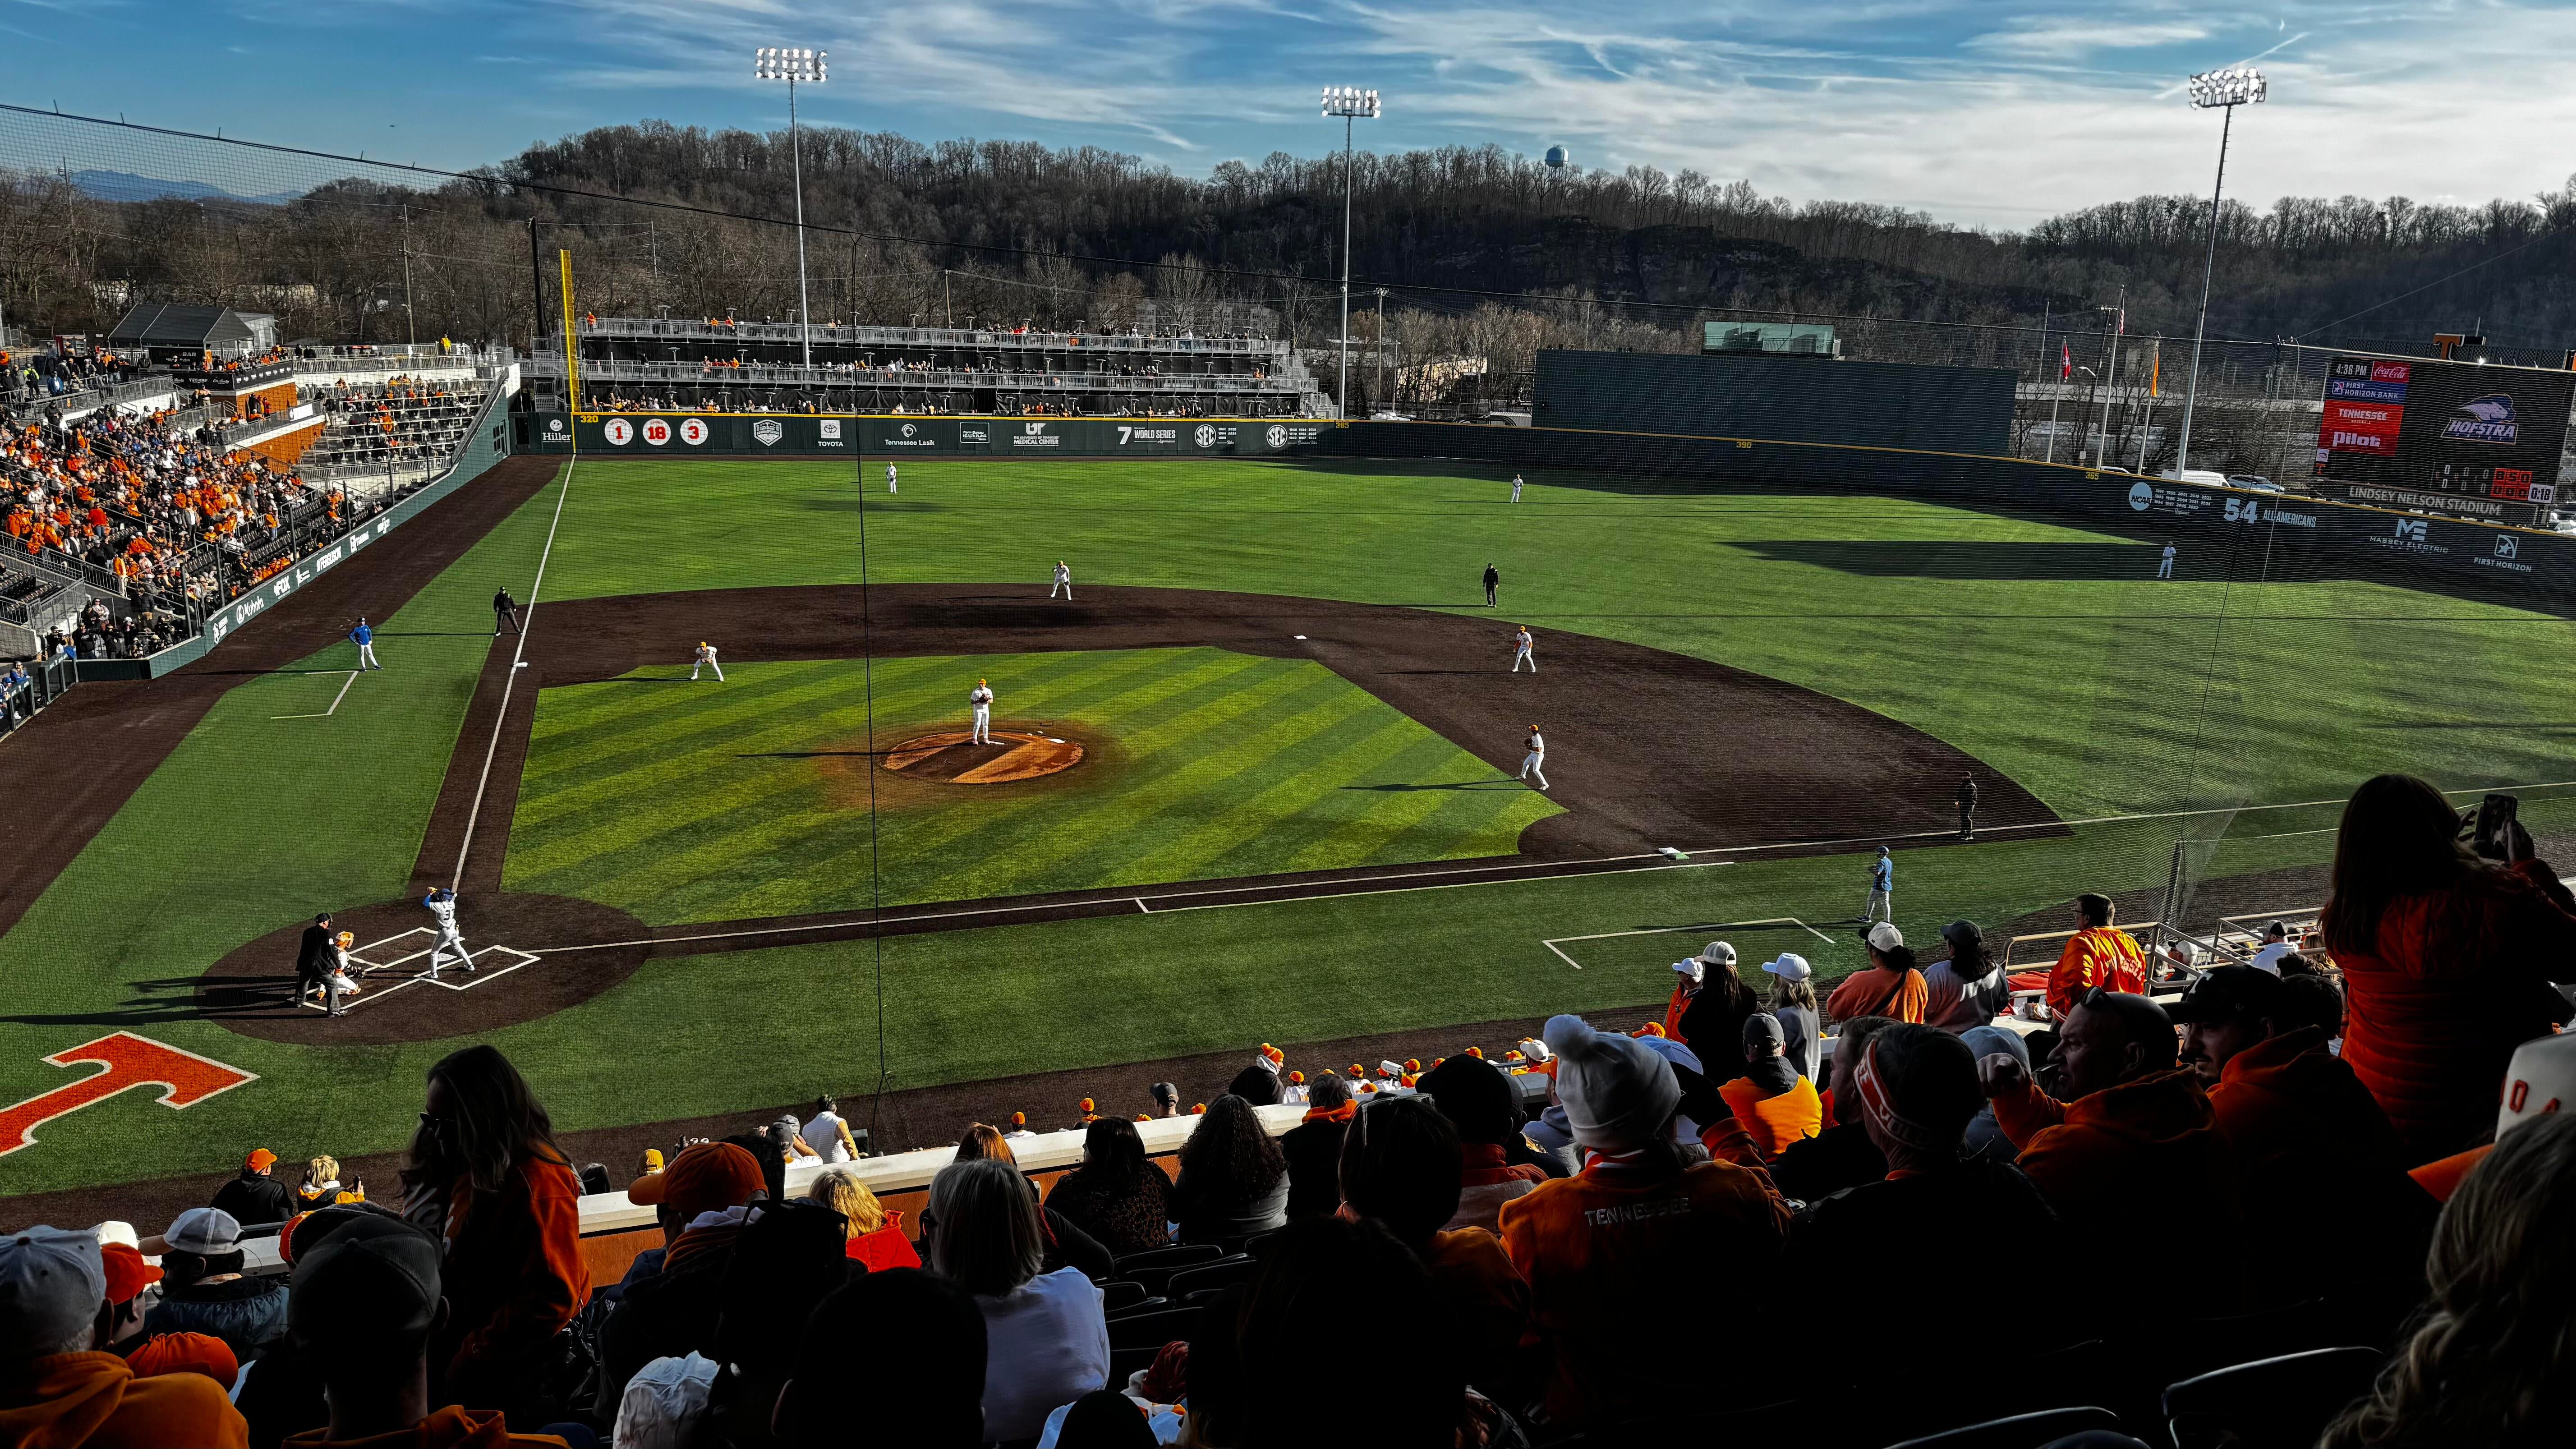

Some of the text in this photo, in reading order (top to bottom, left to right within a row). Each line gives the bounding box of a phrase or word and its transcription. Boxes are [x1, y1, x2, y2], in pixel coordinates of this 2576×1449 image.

[2336, 364, 2367, 375] 4:36 PM
[2339, 409, 2388, 421] TENNESSEE
[615, 426, 623, 439] 1
[648, 426, 666, 439] 18
[688, 426, 699, 439] 3
[1118, 426, 1132, 445] 7
[1134, 430, 1176, 438] WORLD SERIES
[2448, 420, 2515, 437] HOFSTRA
[1197, 426, 1214, 446] SEC
[1269, 426, 1285, 446] SEC
[2085, 472, 2100, 480] 365
[2131, 495, 2151, 504] NCAA
[2350, 486, 2502, 515] LINDSEY NELSON STADIUM
[2531, 488, 2551, 500] 0:18
[2223, 498, 2258, 524] 54
[2263, 509, 2317, 528] ALL-AMERICANS
[2407, 542, 2448, 553] ELECTRIC
[2474, 557, 2532, 572] FIRST HORIZON
[244, 595, 264, 617] Kubota
[1584, 1197, 1691, 1227] TENNESSEE
